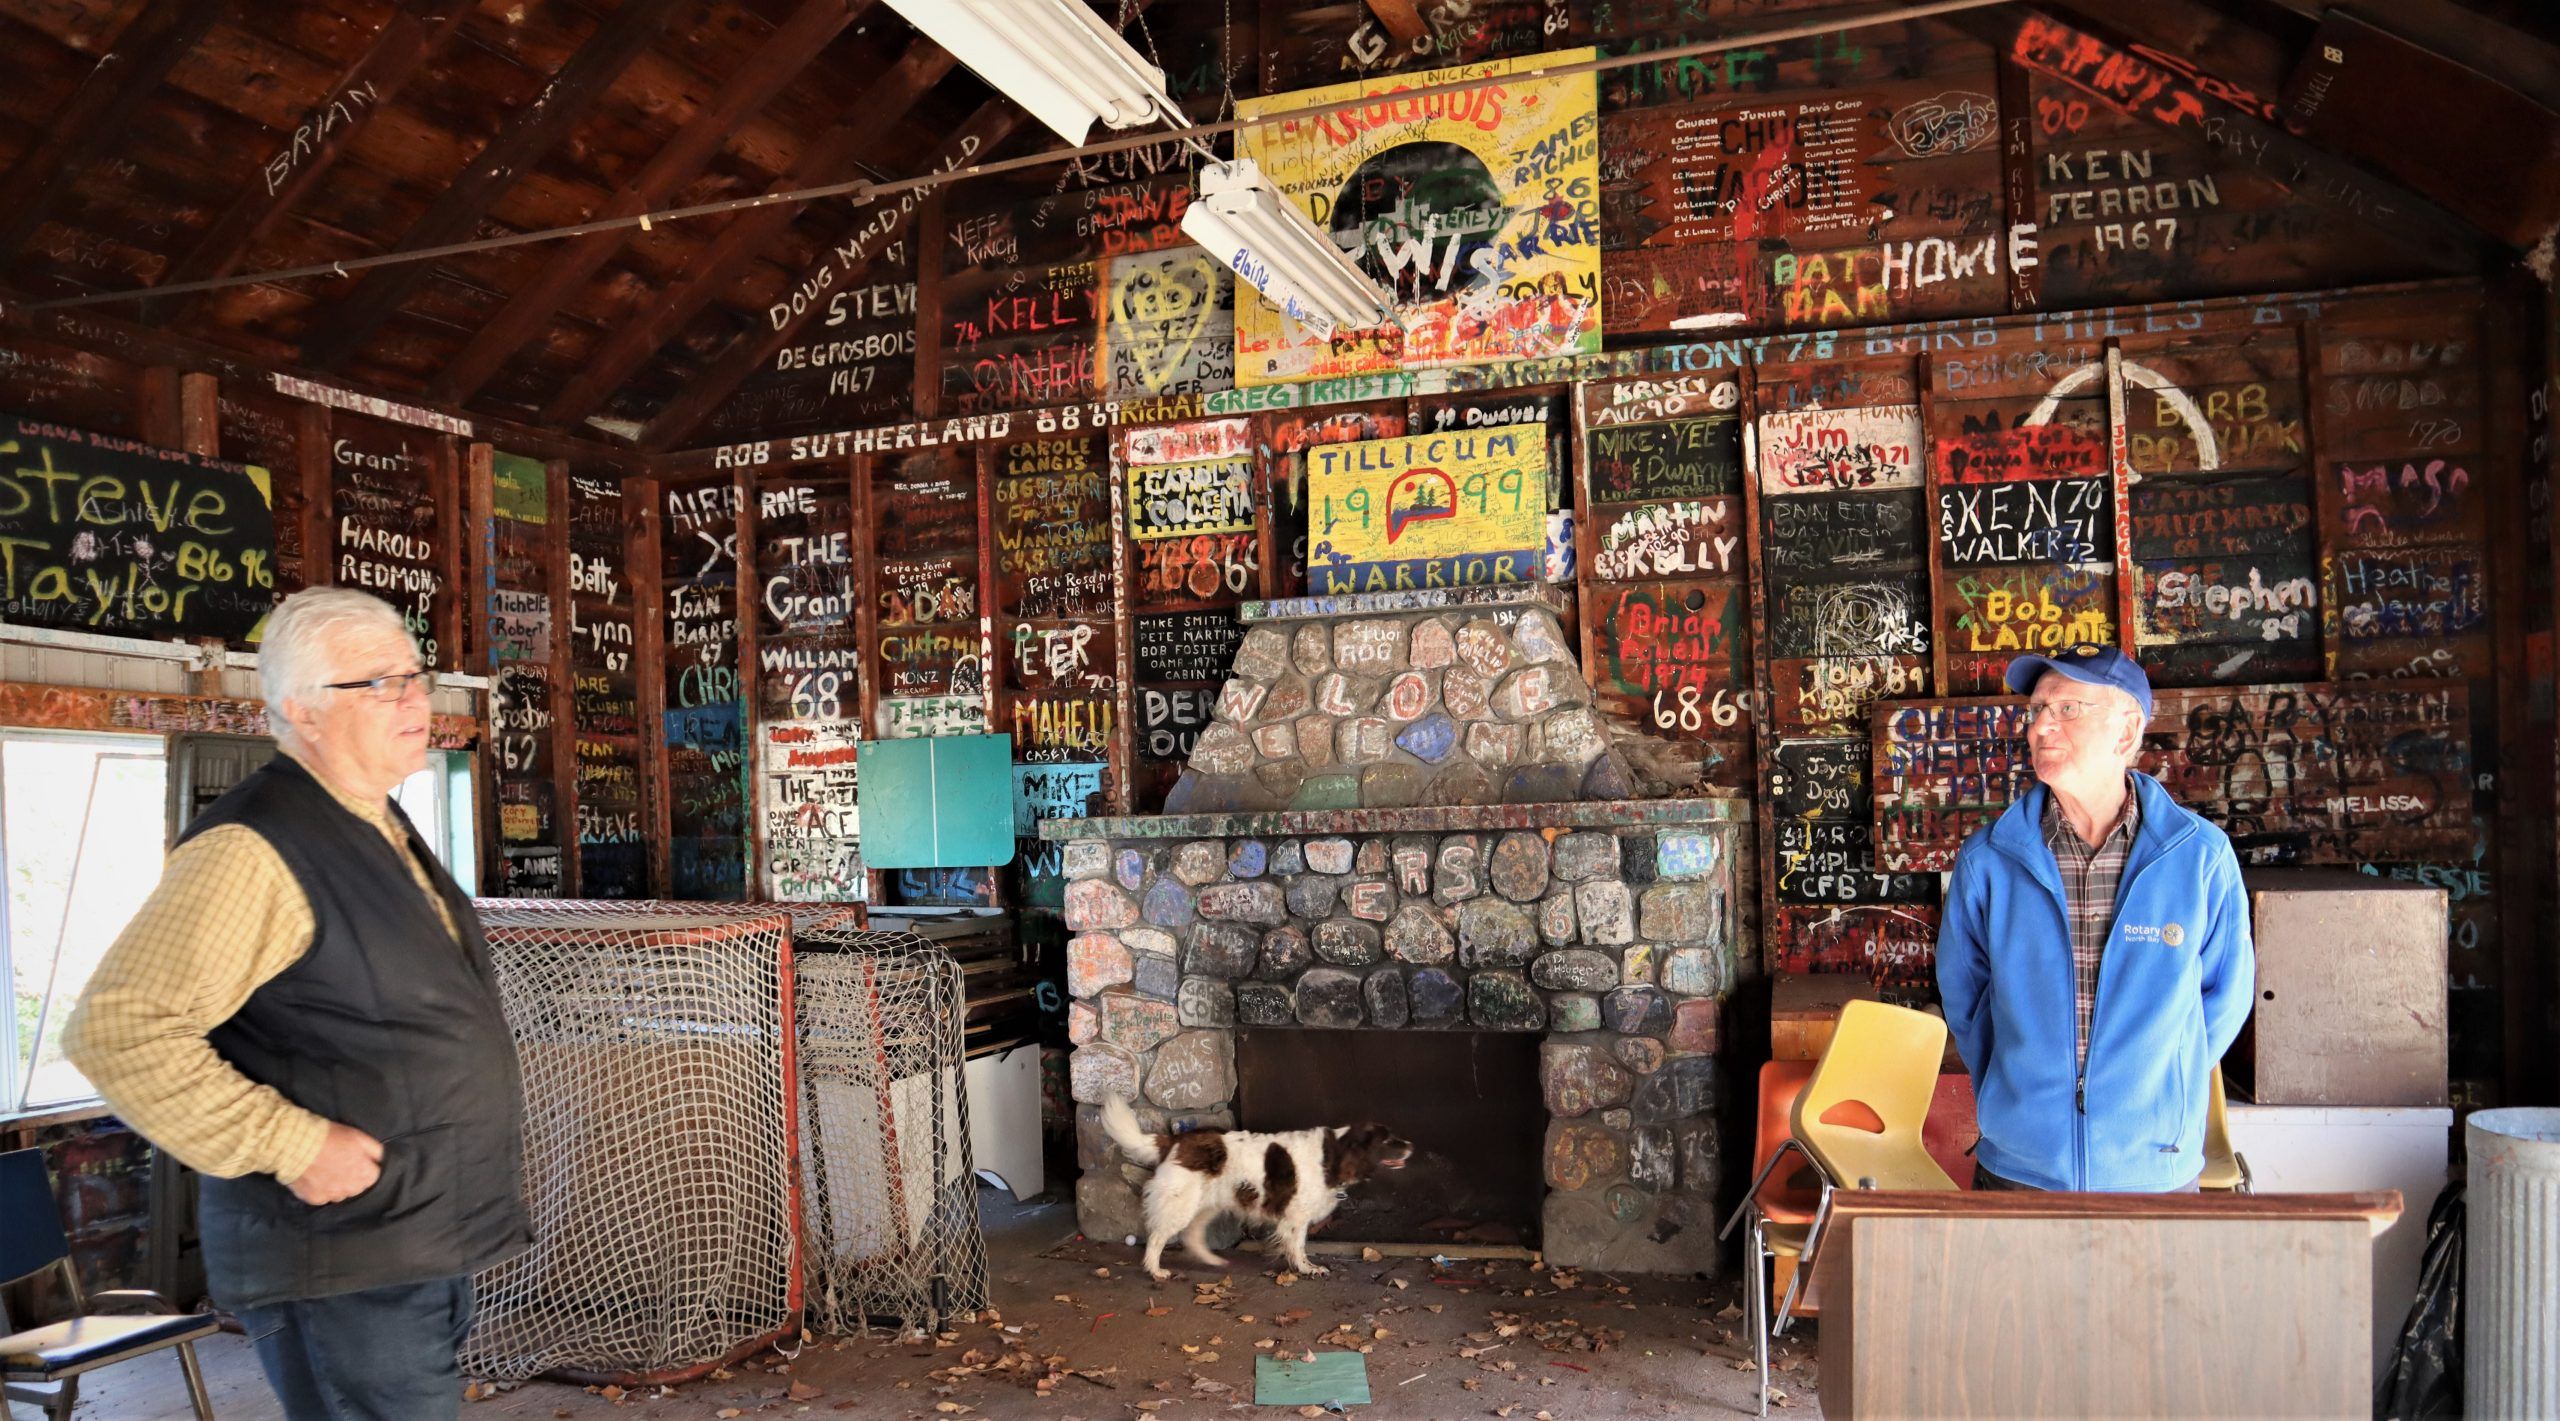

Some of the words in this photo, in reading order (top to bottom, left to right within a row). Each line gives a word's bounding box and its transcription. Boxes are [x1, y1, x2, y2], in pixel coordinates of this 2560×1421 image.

[1427, 66, 1477, 83] NICK
[1675, 117, 1719, 130] CHURCH
[1738, 109, 1787, 122] JUNIOR
[1834, 100, 1863, 111] CAMP
[264, 79, 378, 197] BRIAN
[1509, 110, 1598, 165] JAMES
[2048, 149, 2152, 181] KEN
[1544, 177, 1592, 201] 86
[2049, 174, 2220, 225] FERRON
[2095, 217, 2178, 252] 1967
[1048, 261, 1094, 277] FIRST
[1881, 221, 2039, 292] HOWIE
[769, 266, 834, 332] DOUG
[987, 290, 1100, 336] KELLY
[1664, 336, 1764, 373] TONY
[829, 366, 876, 396] 1967
[1613, 376, 1708, 406] KRISTY
[1207, 387, 1291, 414] GREG
[715, 440, 770, 470] ROB
[790, 412, 1011, 462] SUTHERLAND
[1009, 438, 1092, 458] CAROLE
[1785, 423, 1849, 450] Jim
[334, 438, 412, 471] Grant
[1008, 456, 1089, 476] LANGIS
[1319, 434, 1517, 476] TILLICUM
[1956, 479, 2063, 538] KEN
[2067, 480, 2105, 514] 70
[341, 516, 431, 561] HAROLD
[1951, 530, 2062, 564] WALKER
[570, 553, 619, 605] Betty
[1326, 554, 1519, 597] WARRIOR
[670, 586, 721, 620] JOAN
[765, 575, 854, 622] Grant
[1986, 586, 2064, 623] Bob
[571, 601, 633, 650] Lynn
[1140, 617, 1174, 630] MIKE
[1183, 616, 1228, 627] SMITH
[1629, 603, 1722, 637] Brian
[1140, 631, 1174, 643] PETE
[1141, 645, 1168, 657] BOB
[760, 650, 858, 673] WILLIAM
[1164, 668, 1206, 681] CABIN
[1025, 748, 1071, 762] CASEY
[2327, 794, 2426, 815] MELISSA
[1801, 873, 1858, 900] CFB
[2124, 924, 2161, 938] Rotary
[1864, 938, 1920, 958] DAVID
